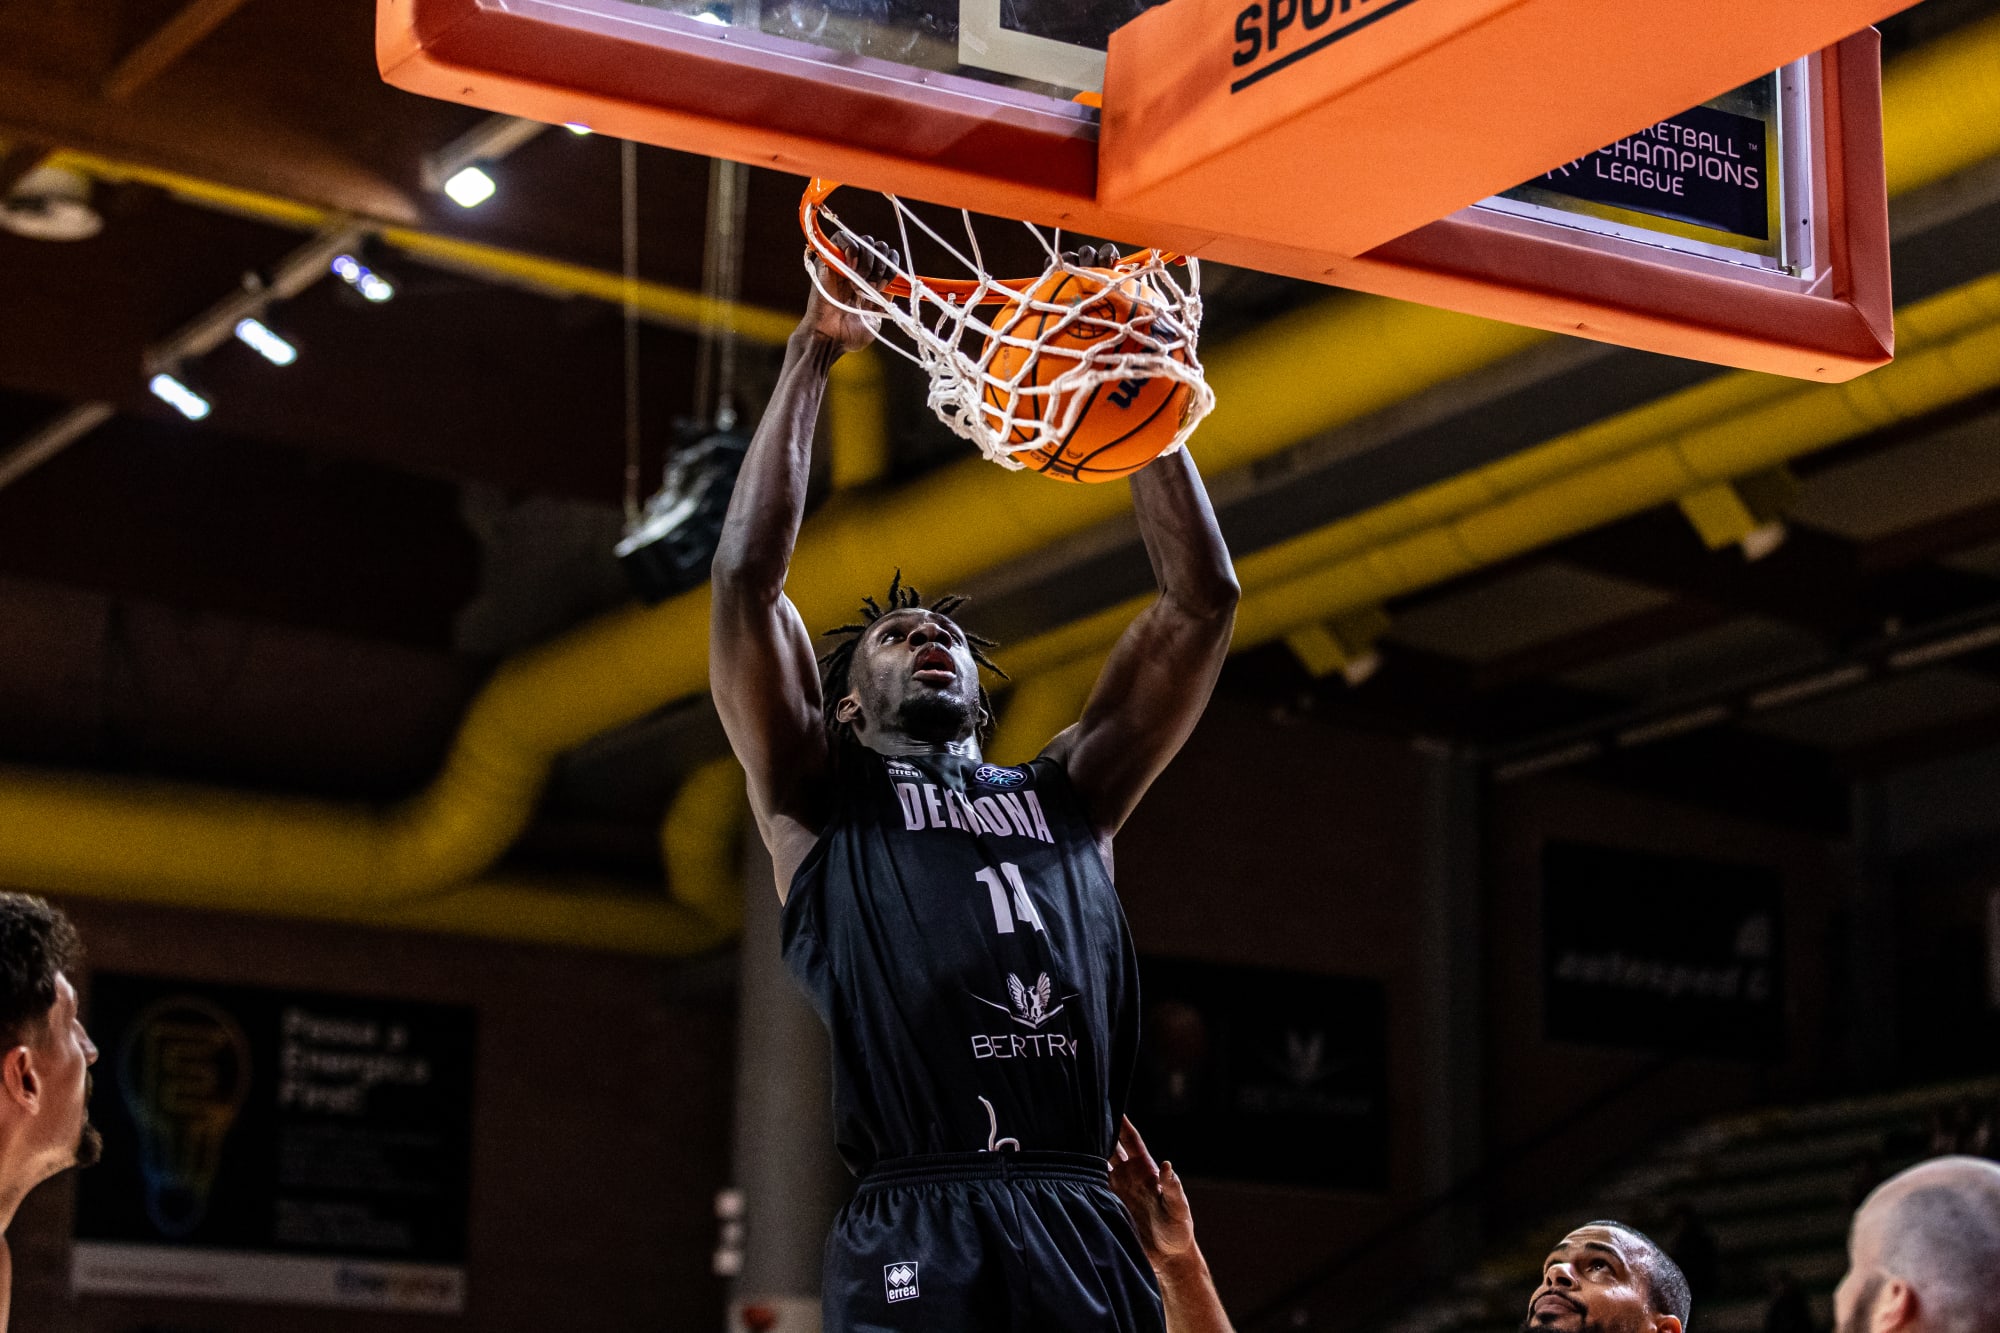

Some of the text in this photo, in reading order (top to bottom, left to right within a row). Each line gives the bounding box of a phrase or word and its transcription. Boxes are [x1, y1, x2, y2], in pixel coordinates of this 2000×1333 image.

[1596, 158, 1685, 197] LEAGUE
[1598, 137, 1759, 190] HAMPIONS
[974, 862, 1044, 934] 14
[888, 1285, 916, 1299] errea
